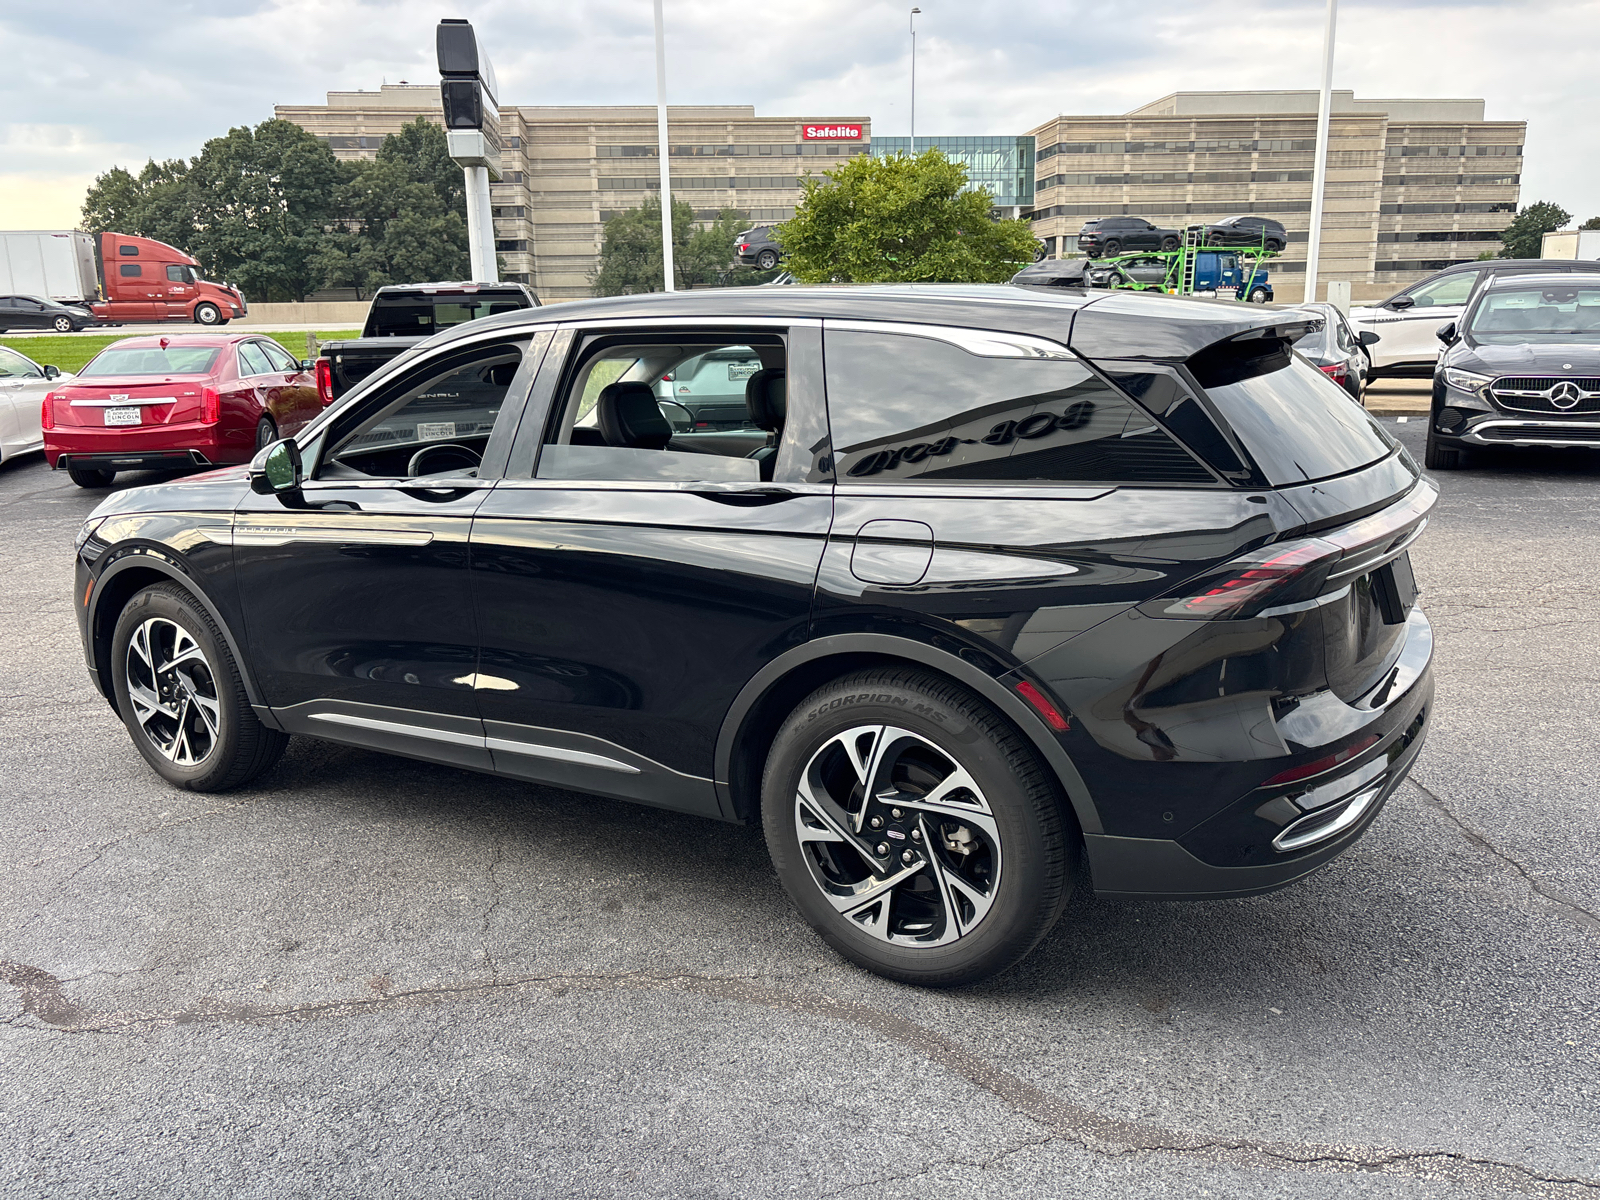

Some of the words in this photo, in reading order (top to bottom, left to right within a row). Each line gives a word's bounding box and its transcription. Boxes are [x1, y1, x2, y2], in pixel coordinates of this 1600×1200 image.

[806, 126, 858, 138] Safelite
[807, 692, 909, 723] SCORPION
[912, 703, 949, 723] MS
